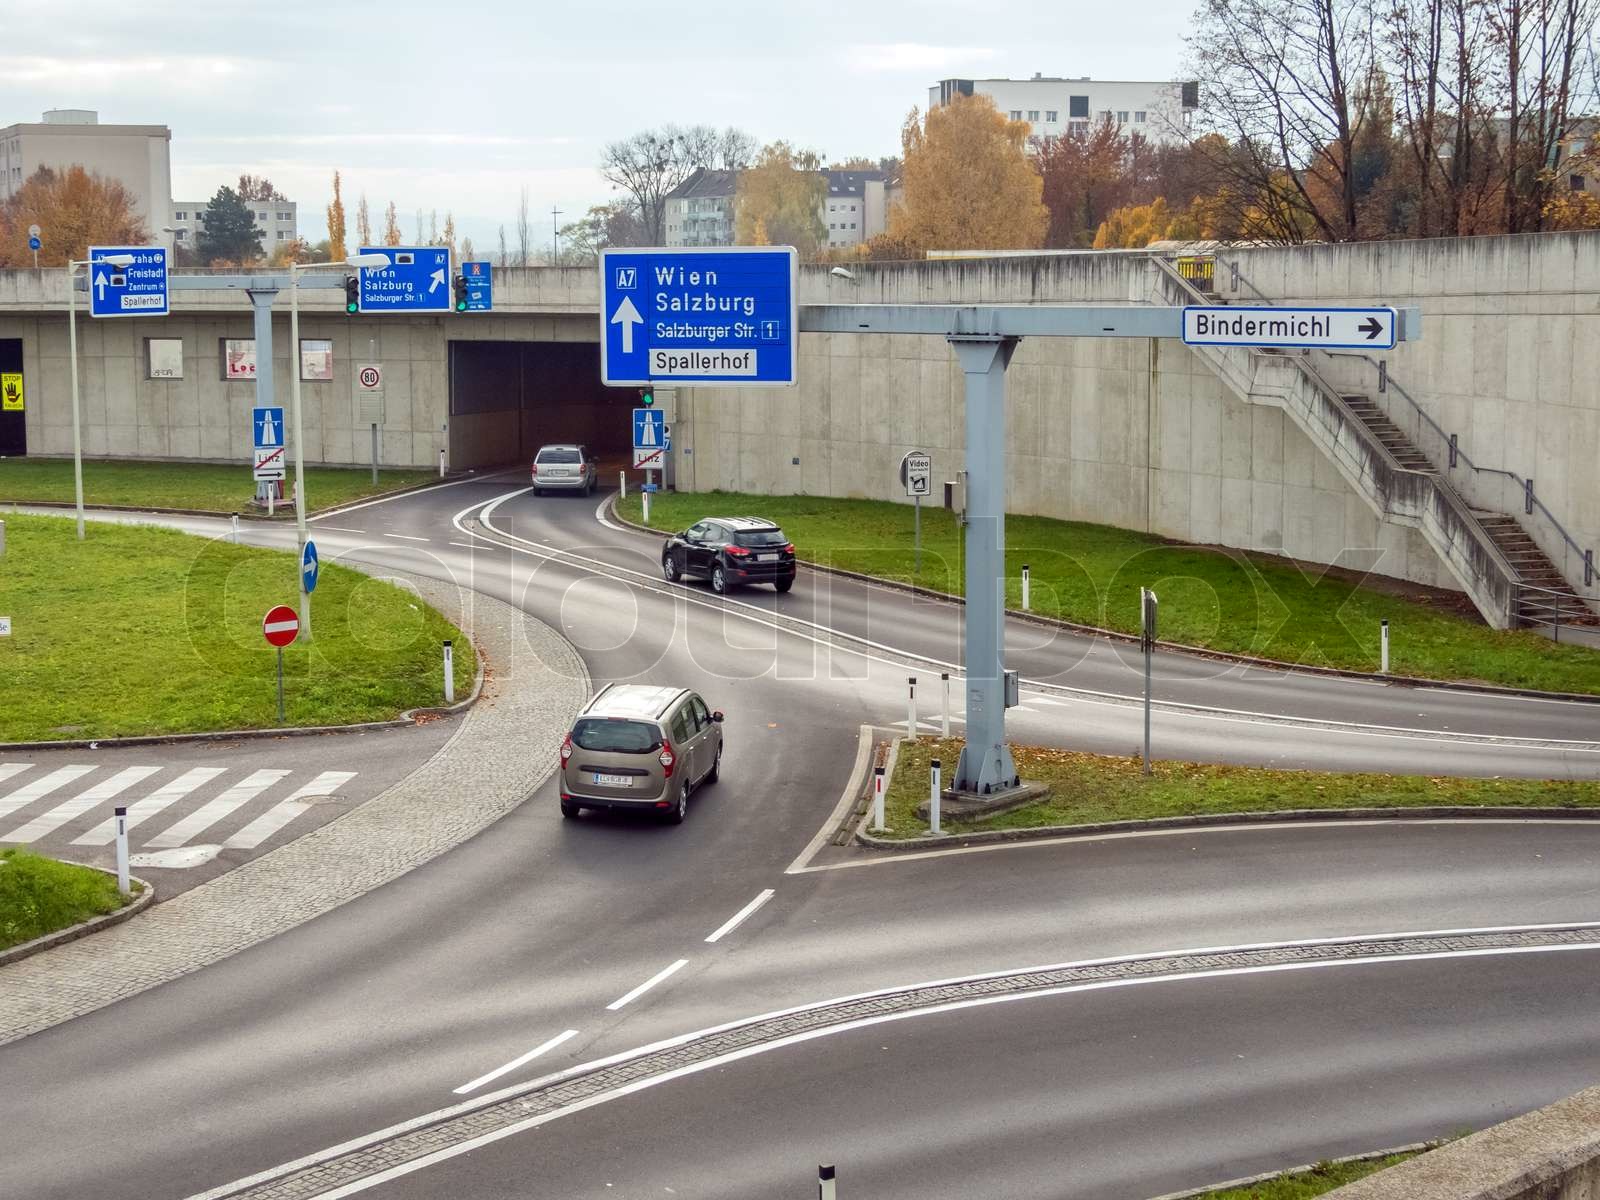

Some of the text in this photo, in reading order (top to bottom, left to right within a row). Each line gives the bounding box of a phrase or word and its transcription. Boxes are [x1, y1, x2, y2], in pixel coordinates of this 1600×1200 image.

[436, 255, 445, 264] A7
[128, 268, 164, 278] Freistadt
[365, 268, 396, 278] Wien
[618, 269, 635, 287] A7
[655, 266, 718, 286] Wien
[128, 282, 158, 291] Zentrum
[365, 281, 413, 292] Salzburg
[123, 296, 162, 307] Spallerhof
[365, 294, 403, 303] Salzburger
[655, 292, 755, 316] Salzburg
[1196, 314, 1331, 338] Bindermichl
[656, 322, 731, 342] Salzburger
[734, 322, 758, 338] Str.
[656, 351, 750, 373] Spallerhof
[364, 372, 375, 383] 80
[258, 453, 280, 463] Linz
[638, 453, 660, 463] Linz
[909, 460, 929, 468] Video
